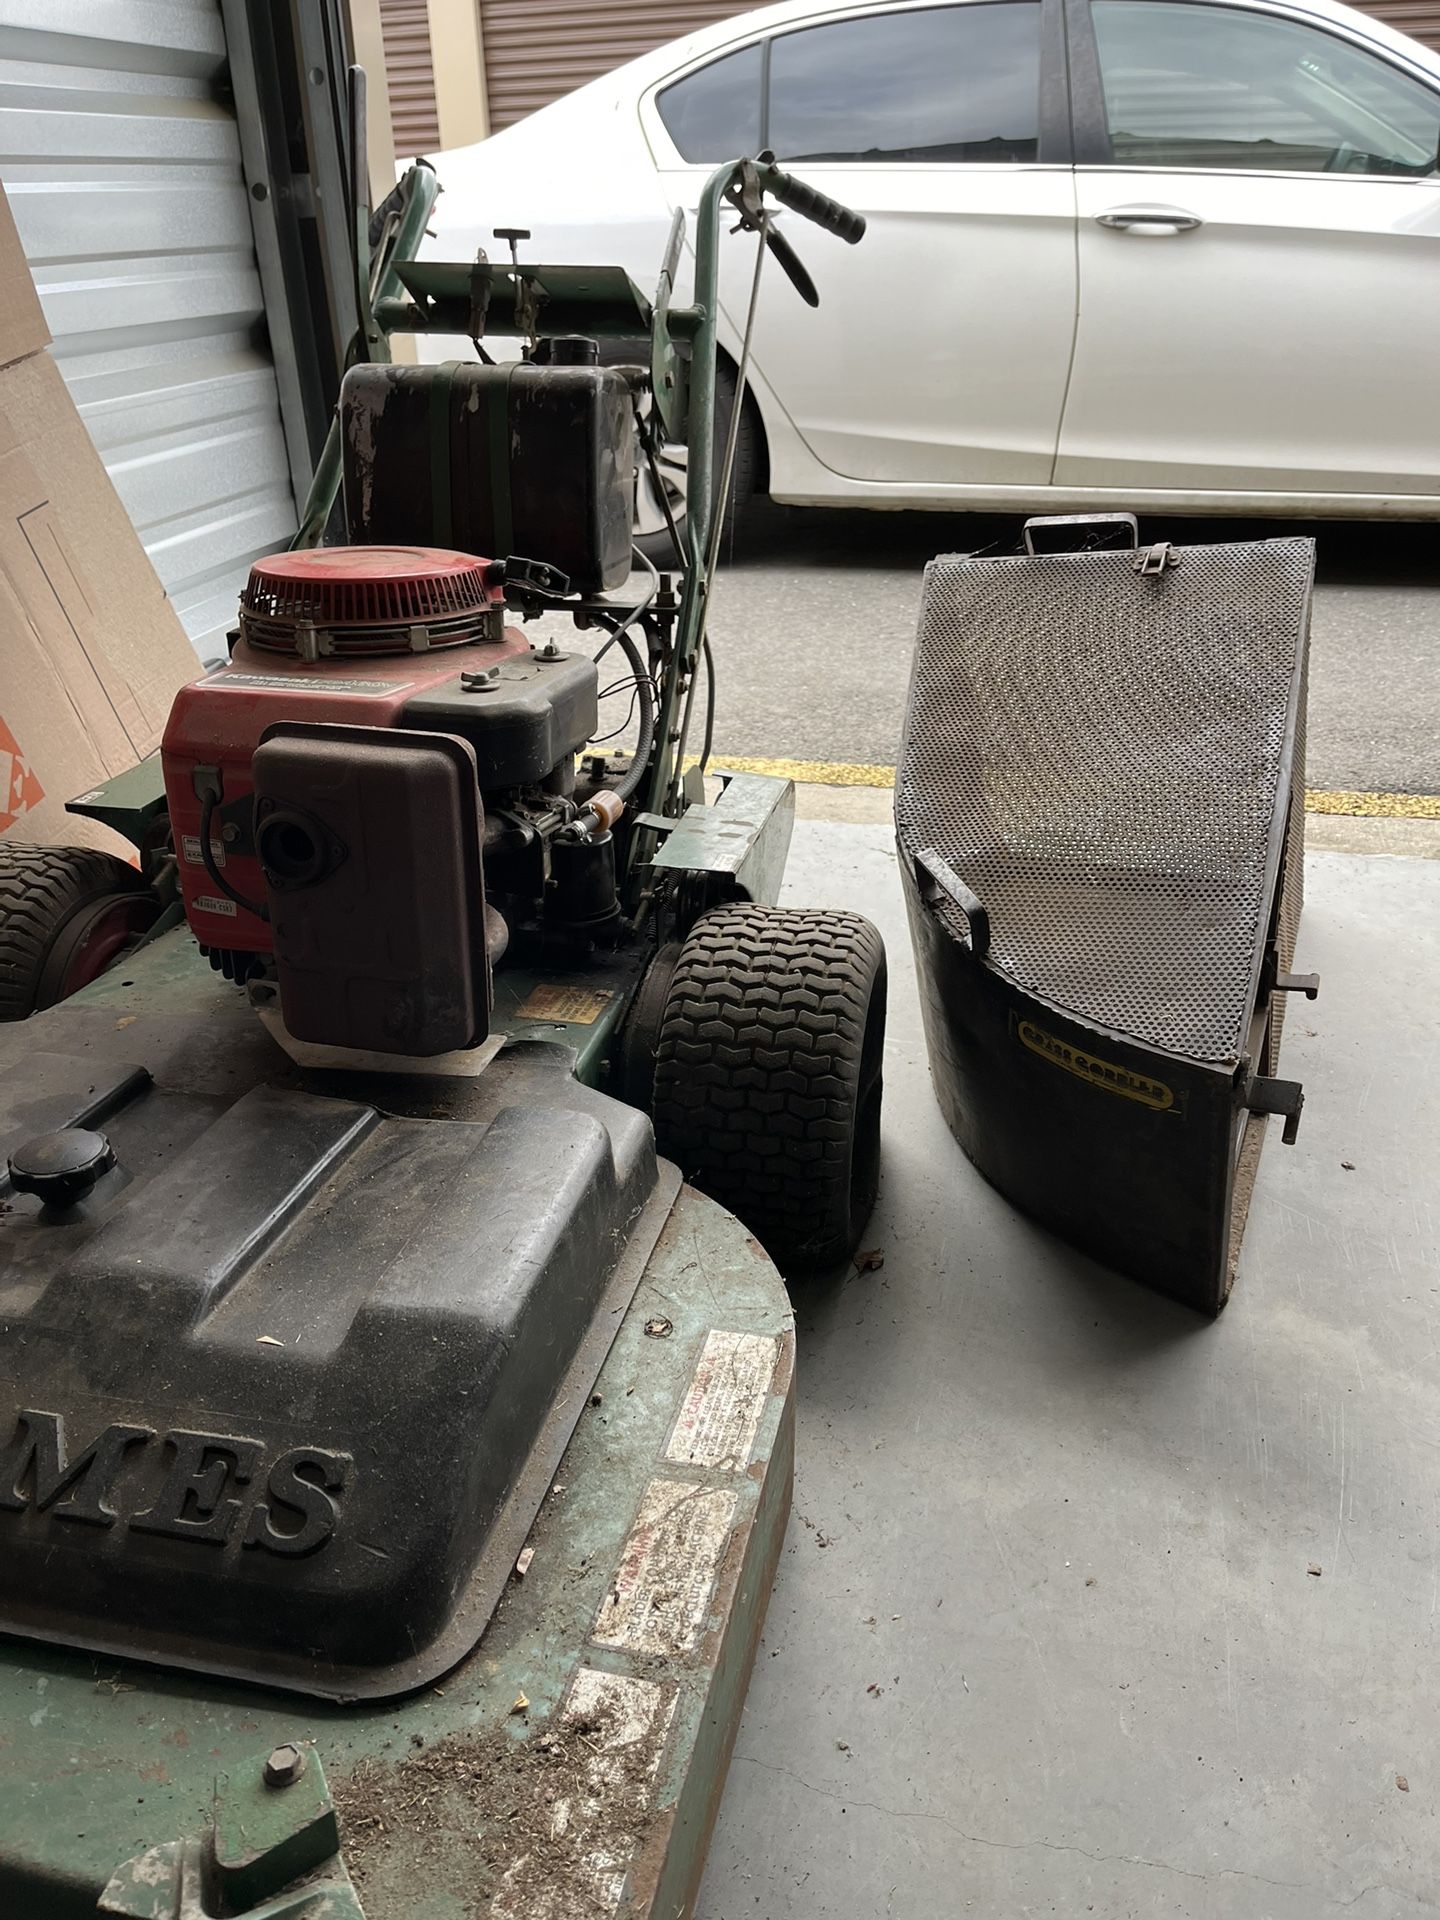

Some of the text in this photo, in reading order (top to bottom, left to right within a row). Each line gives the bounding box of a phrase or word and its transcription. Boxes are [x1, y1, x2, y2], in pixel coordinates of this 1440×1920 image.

[225, 673, 312, 684] Kawasaki
[1022, 1026, 1072, 1064] GRASS
[614, 1521, 656, 1594] WARNING
